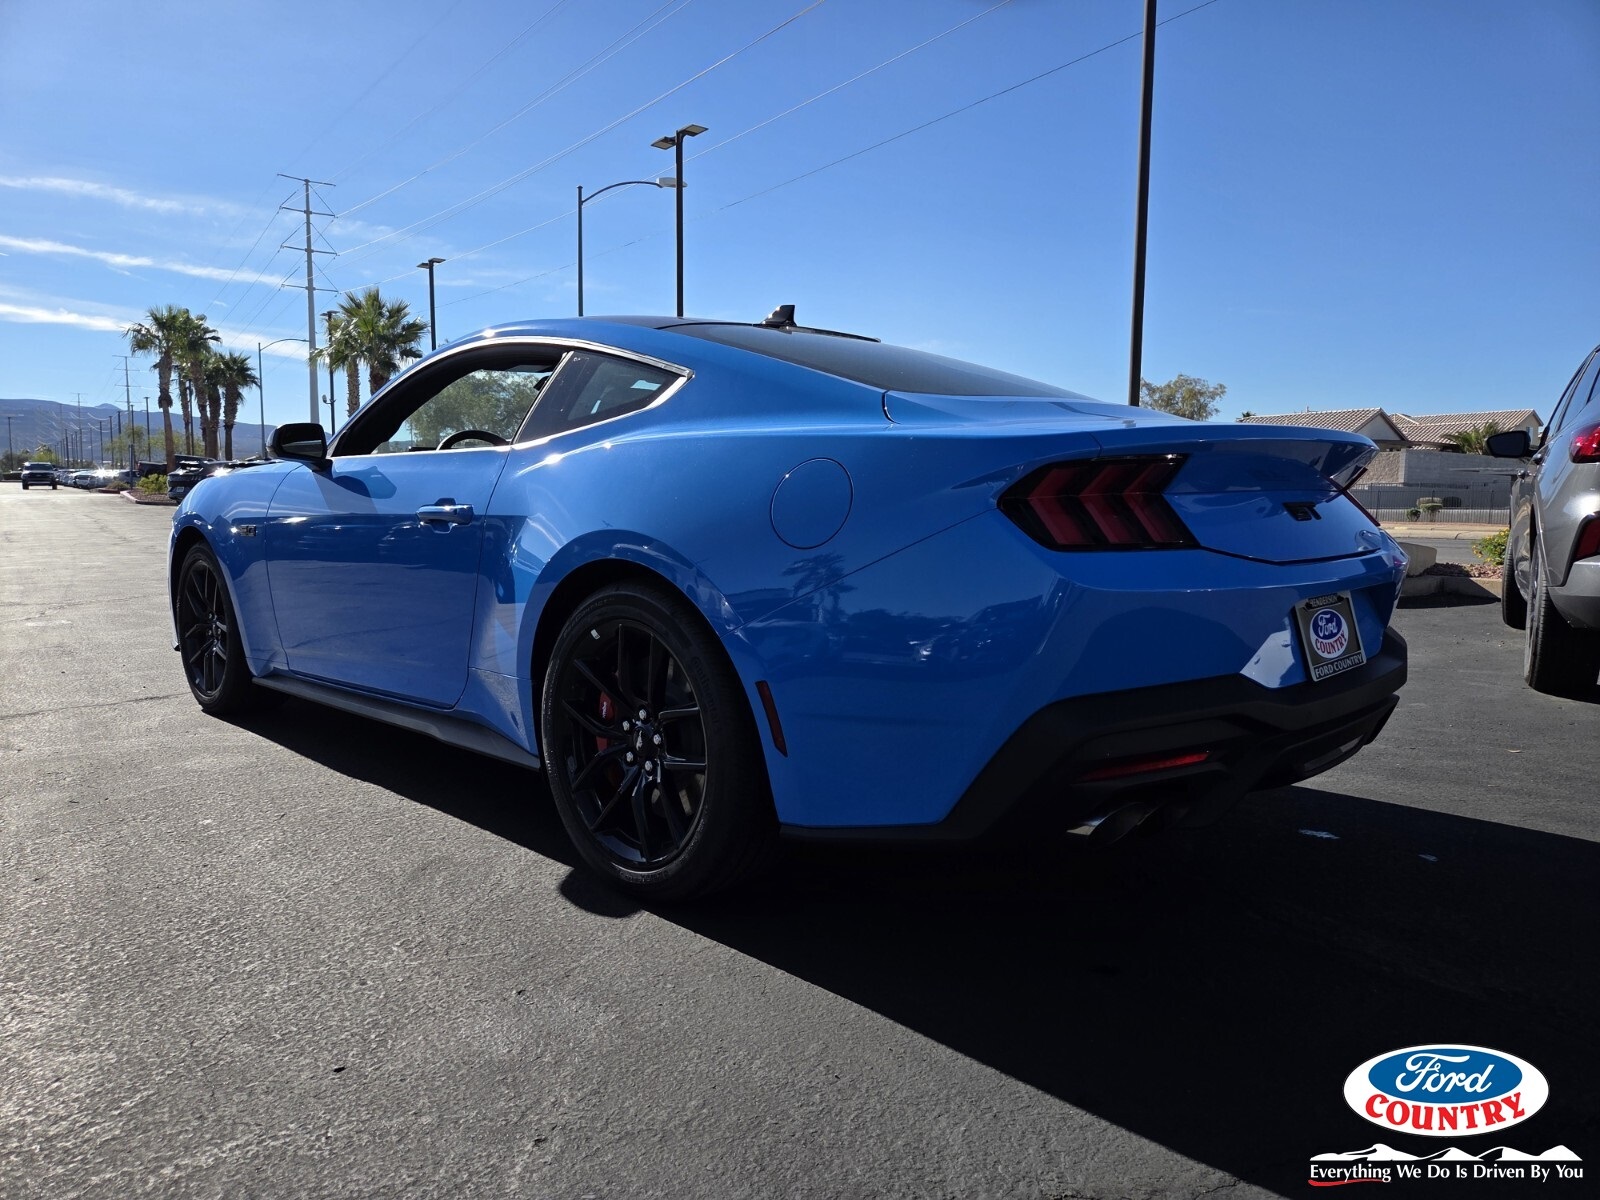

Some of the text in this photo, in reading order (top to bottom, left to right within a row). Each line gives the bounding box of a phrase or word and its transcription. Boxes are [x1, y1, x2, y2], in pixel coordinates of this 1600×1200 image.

[1318, 614, 1338, 637] Ford
[1315, 631, 1347, 654] COUNTRY
[1315, 654, 1363, 678] FORD COUNTRY
